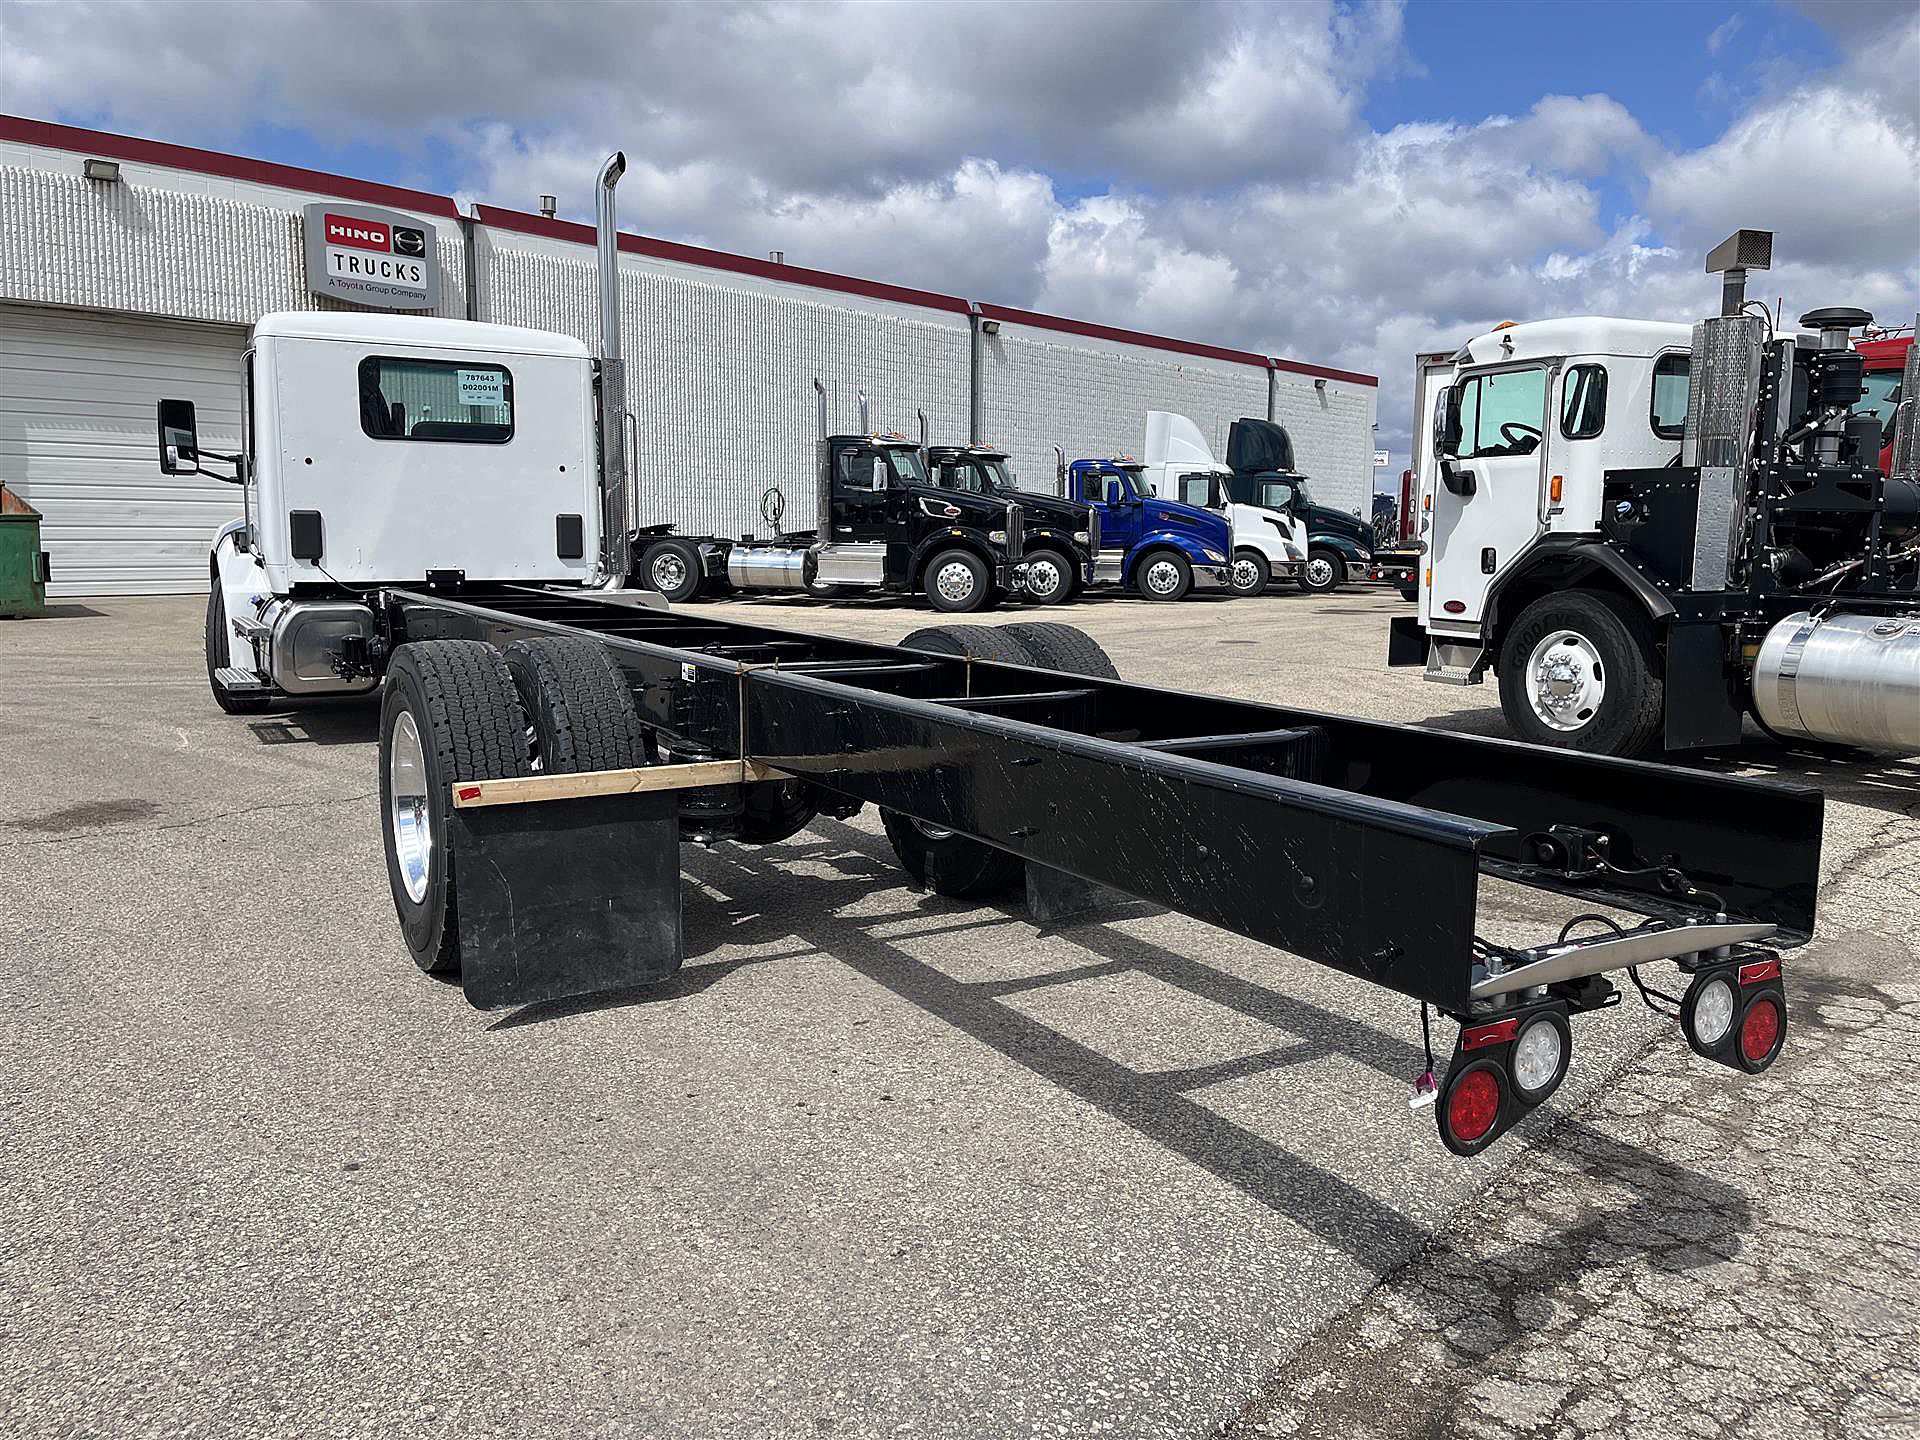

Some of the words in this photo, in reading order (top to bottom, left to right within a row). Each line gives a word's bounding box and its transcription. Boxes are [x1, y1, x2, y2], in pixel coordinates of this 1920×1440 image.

[330, 225, 385, 243] HINO
[333, 253, 420, 282] TRUCKS
[329, 279, 335, 287] A
[338, 279, 364, 291] Toyota
[365, 284, 390, 295] Group
[391, 287, 427, 300] Company
